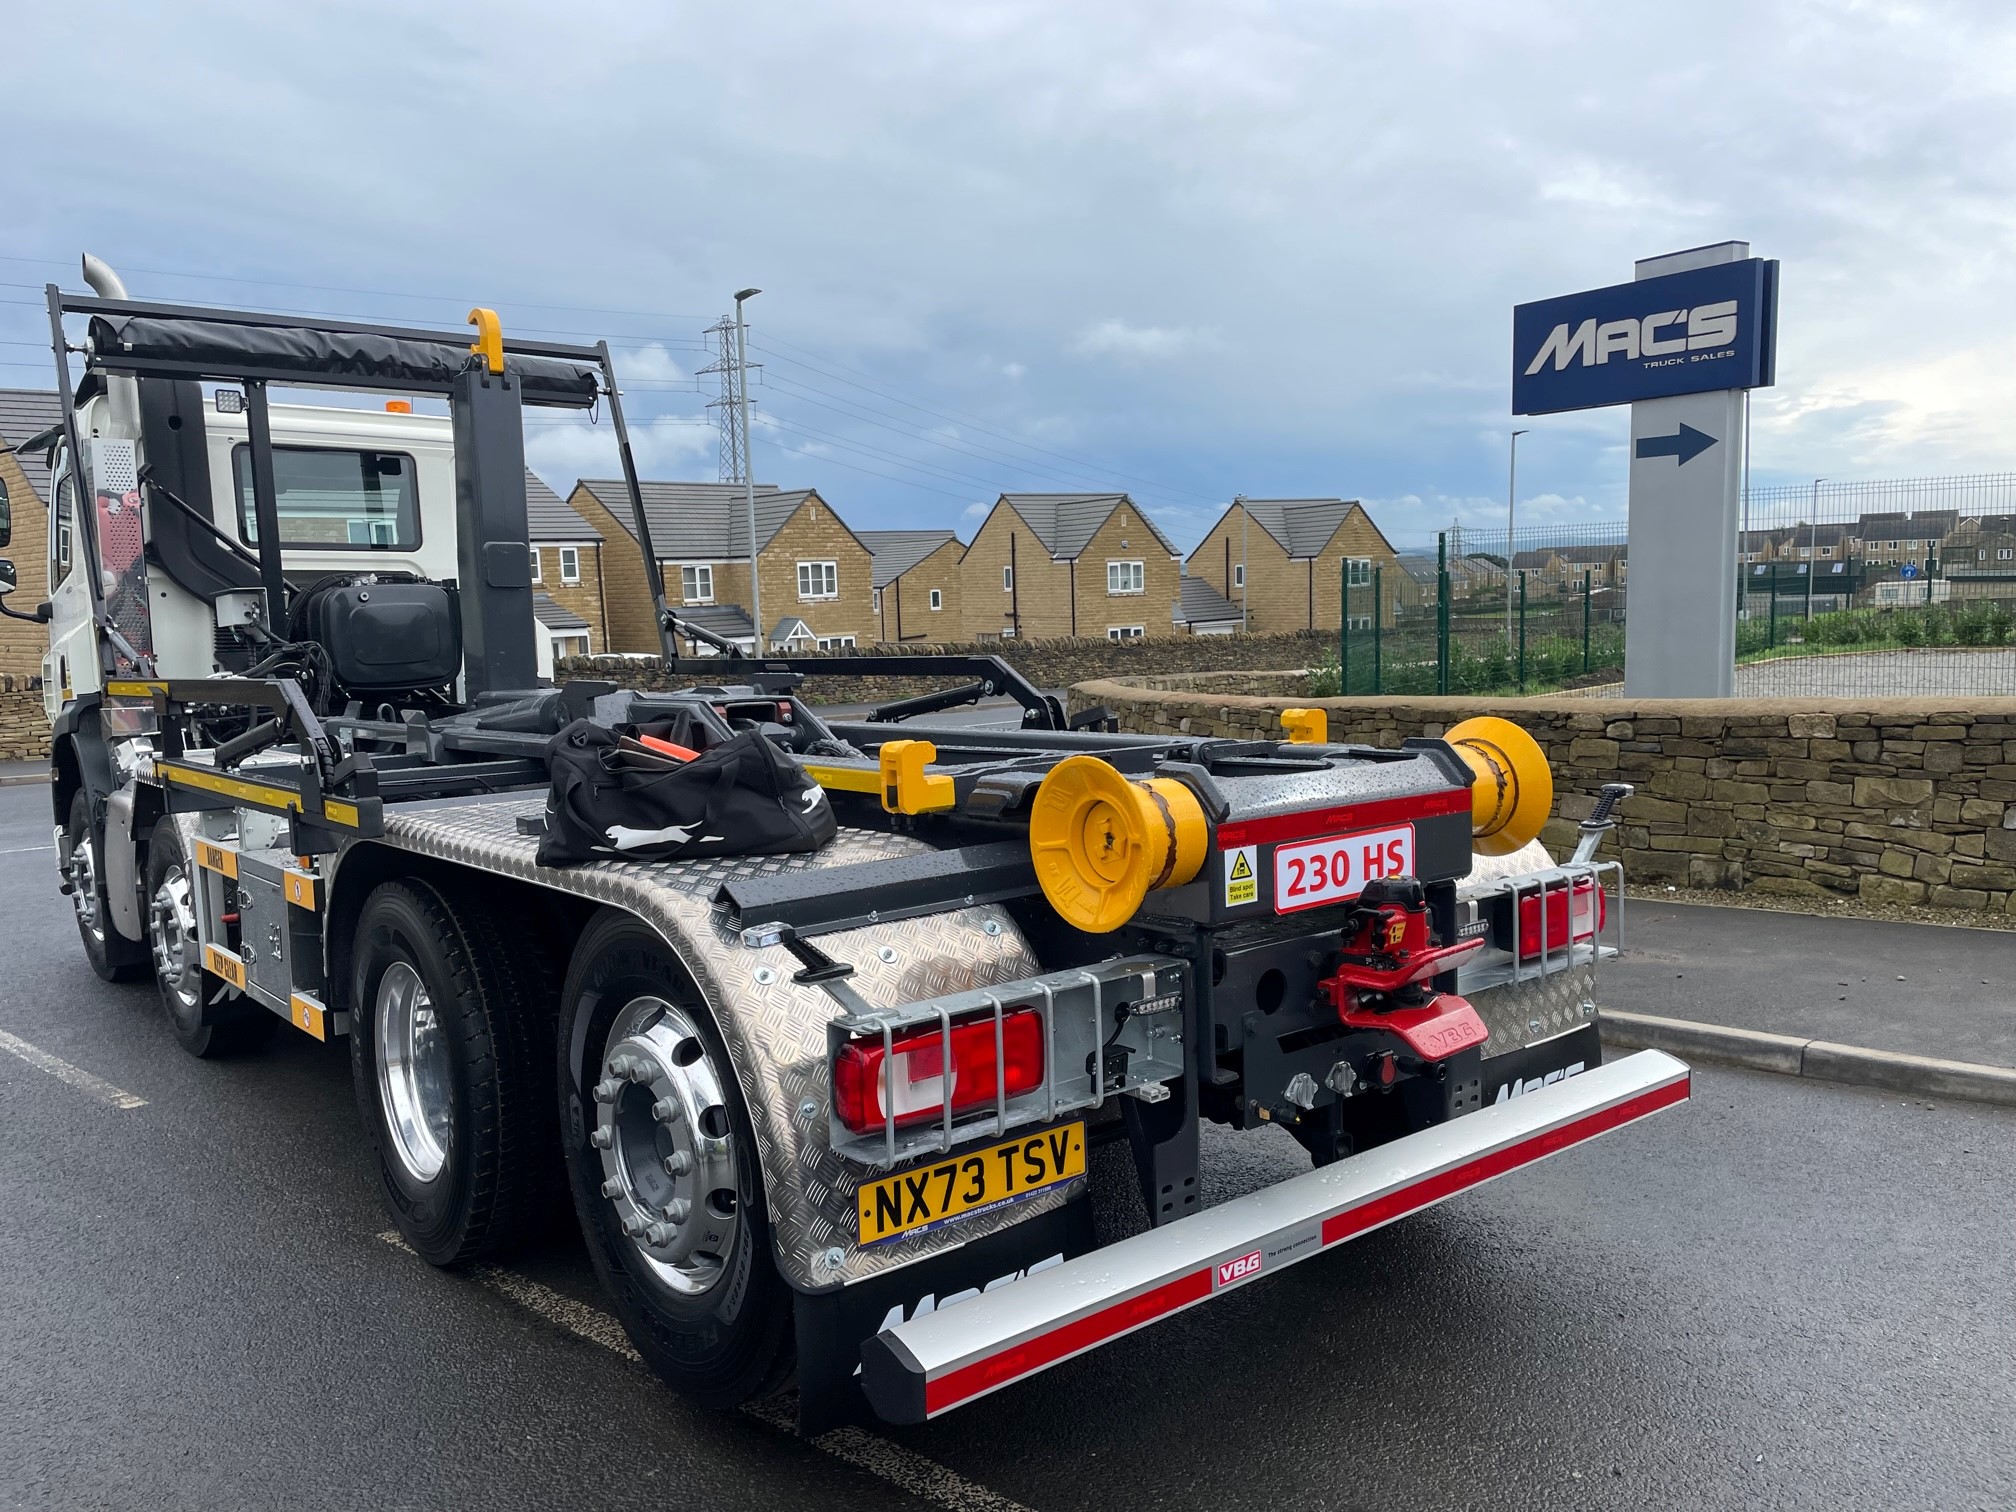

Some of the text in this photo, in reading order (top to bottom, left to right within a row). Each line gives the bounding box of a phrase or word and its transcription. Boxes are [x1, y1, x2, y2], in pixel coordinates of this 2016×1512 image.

[1643, 350, 1735, 369] TRUCK SALES
[206, 846, 224, 871] DANGER
[1287, 839, 1405, 897] 230 HS
[1229, 883, 1253, 893] Blind spot
[213, 951, 238, 984] KEEP CLEAR
[1430, 1022, 1477, 1048] VBG
[876, 1130, 1069, 1234] NX73 TSV
[943, 1197, 1015, 1225] www.macstrucks.co.uk
[1220, 1253, 1259, 1281] VBG
[1277, 1244, 1292, 1254] strong
[1293, 1234, 1317, 1248] connection
